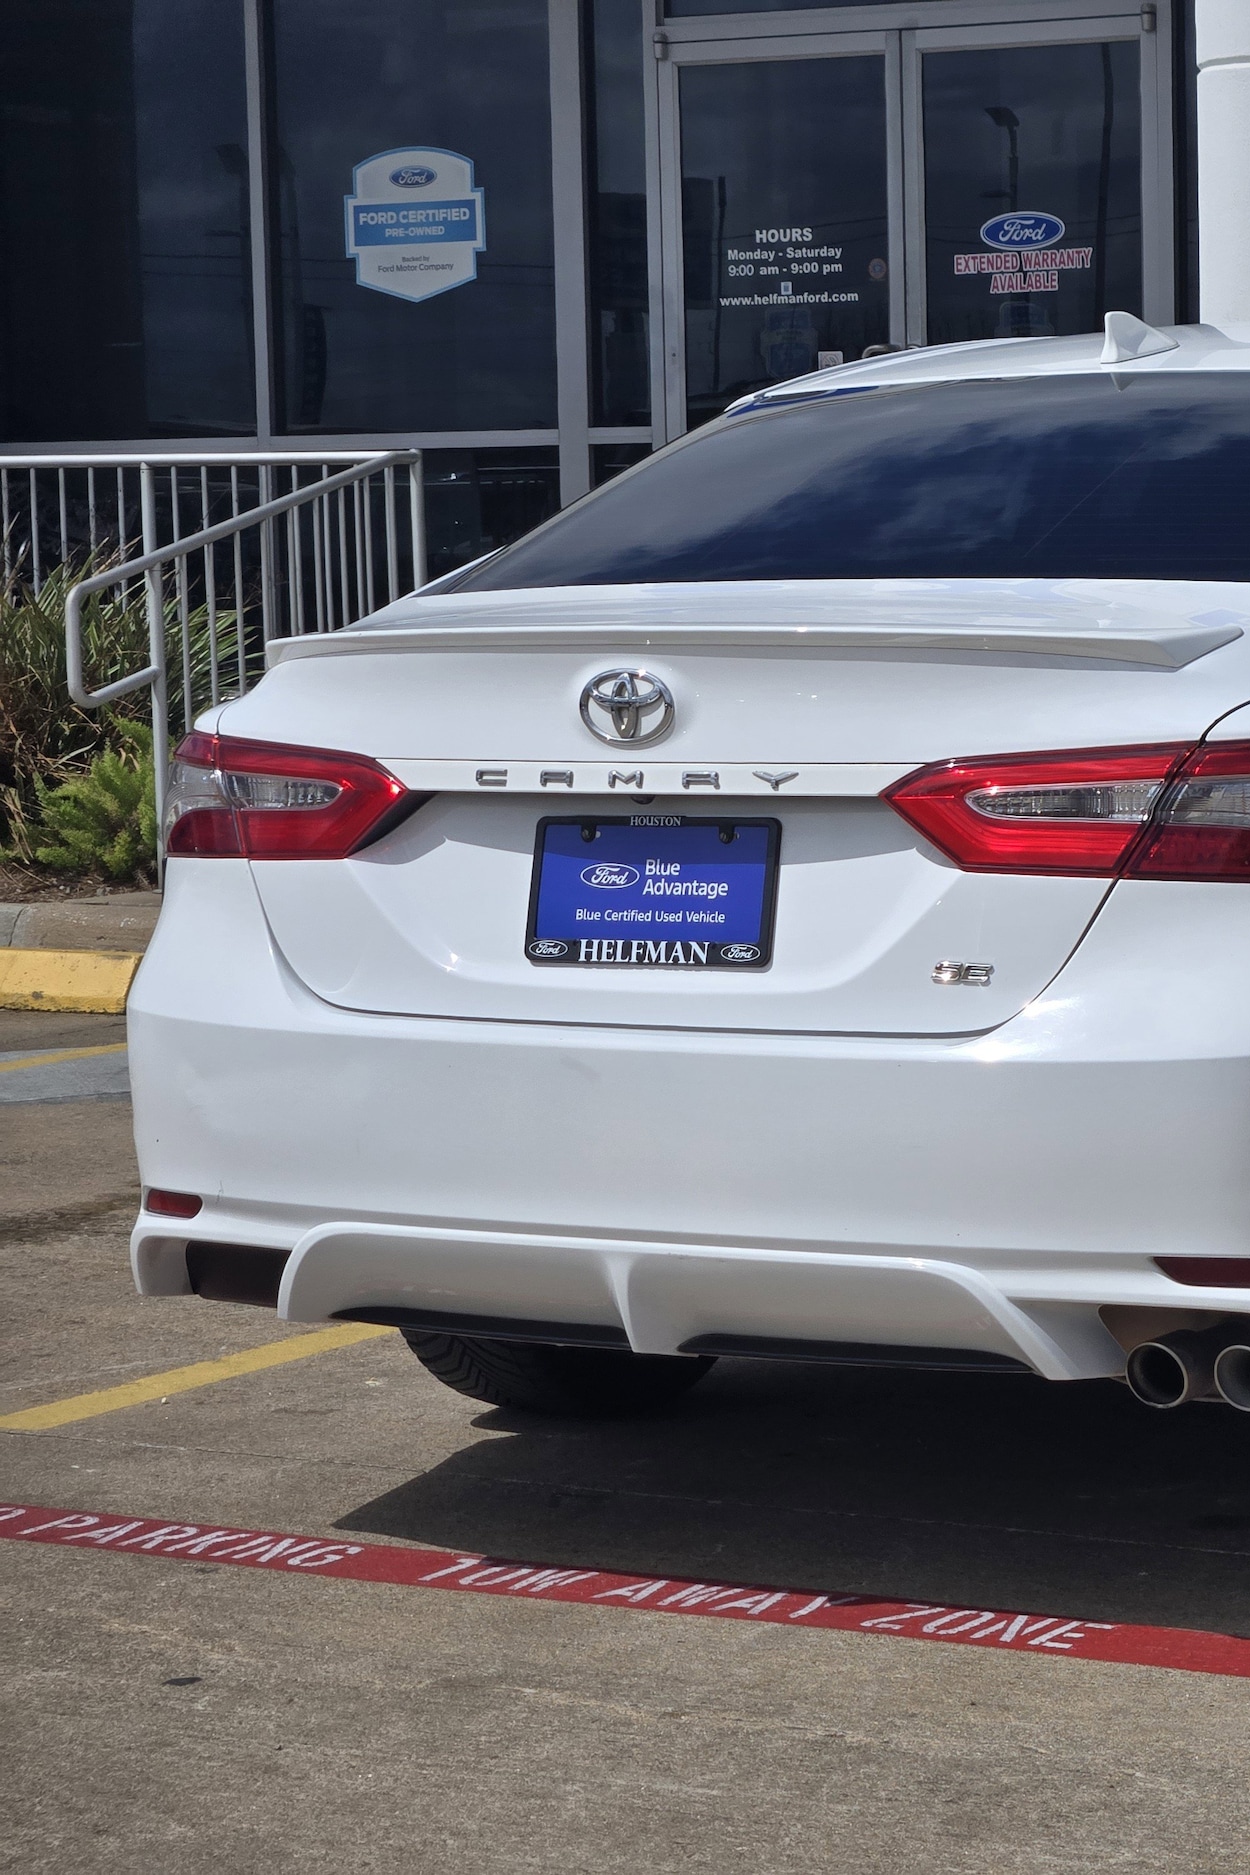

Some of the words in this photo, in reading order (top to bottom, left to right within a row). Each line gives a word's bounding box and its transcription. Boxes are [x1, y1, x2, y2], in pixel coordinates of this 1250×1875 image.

[359, 212, 397, 225] FORD
[400, 208, 470, 223] CERTIFIED
[385, 226, 445, 237] PRE-OWNED
[755, 228, 813, 243] HOURS
[998, 219, 1047, 241] Ford
[728, 249, 775, 262] Monday
[786, 246, 843, 259] Saturday
[954, 252, 1020, 274] EXTENDED
[1021, 247, 1093, 271] WARRANTY
[378, 265, 394, 273] Ford
[396, 264, 417, 272] Motor
[419, 263, 454, 272] Company
[728, 265, 754, 277] 9:00
[759, 267, 779, 275] am
[791, 262, 819, 274] 9:00
[823, 263, 843, 275] pm
[990, 271, 1058, 294] AVAILABLE
[719, 291, 859, 306] www.helfmanford.com
[475, 769, 800, 791] CAMRY
[630, 816, 681, 827] HOUSTON
[645, 859, 680, 876] Blue
[642, 879, 728, 899] Advantage
[575, 909, 601, 921] Blue
[604, 909, 652, 922] Certified
[655, 910, 682, 923] Used
[685, 911, 725, 923] Vehicle
[578, 939, 710, 965] HELFMAN
[931, 960, 994, 986] SE
[16, 1514, 365, 1567] PARKING
[418, 1558, 600, 1592] TOW
[590, 1580, 861, 1619] AWAY
[860, 1603, 1121, 1649] ZONE
